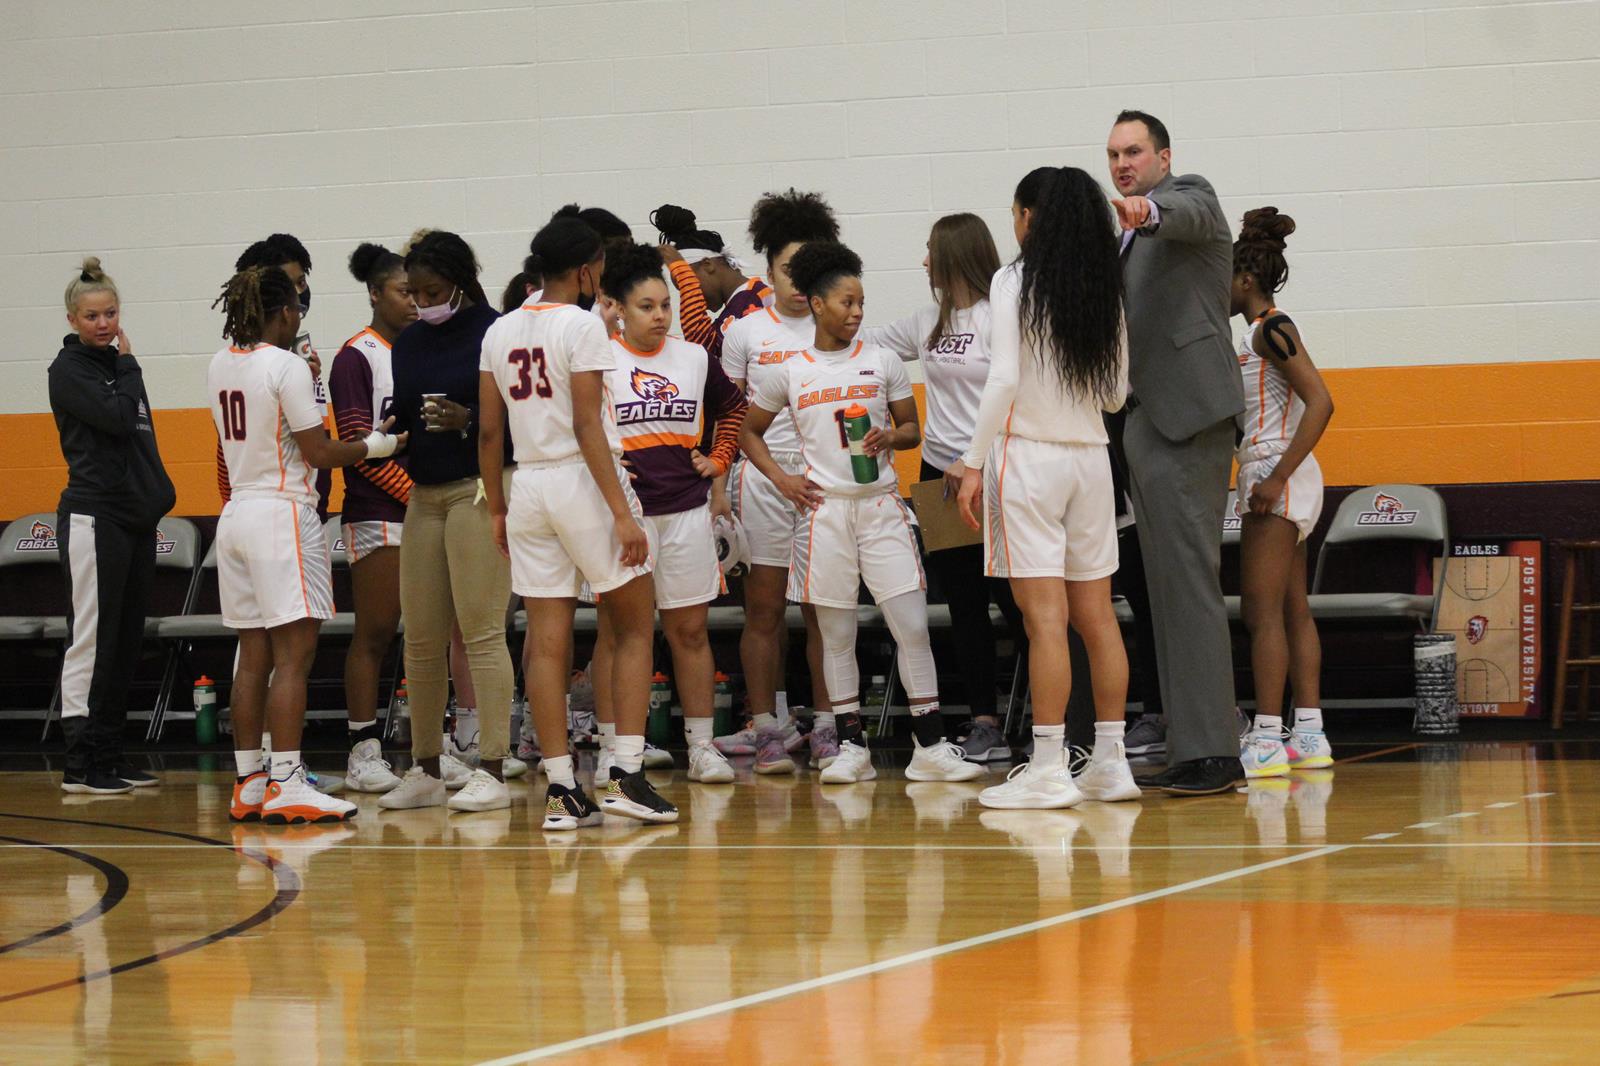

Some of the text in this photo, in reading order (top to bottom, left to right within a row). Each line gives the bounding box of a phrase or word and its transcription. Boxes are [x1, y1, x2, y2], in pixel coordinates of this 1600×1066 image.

[937, 333, 975, 354] OST
[508, 347, 553, 401] 33
[797, 384, 880, 411] EAGLES
[218, 389, 248, 442] 10
[615, 400, 698, 425] EAGLES
[1359, 512, 1414, 524] EAGLES
[1455, 545, 1499, 555] EAGLES
[1523, 557, 1535, 704] POST UNIVERSITY
